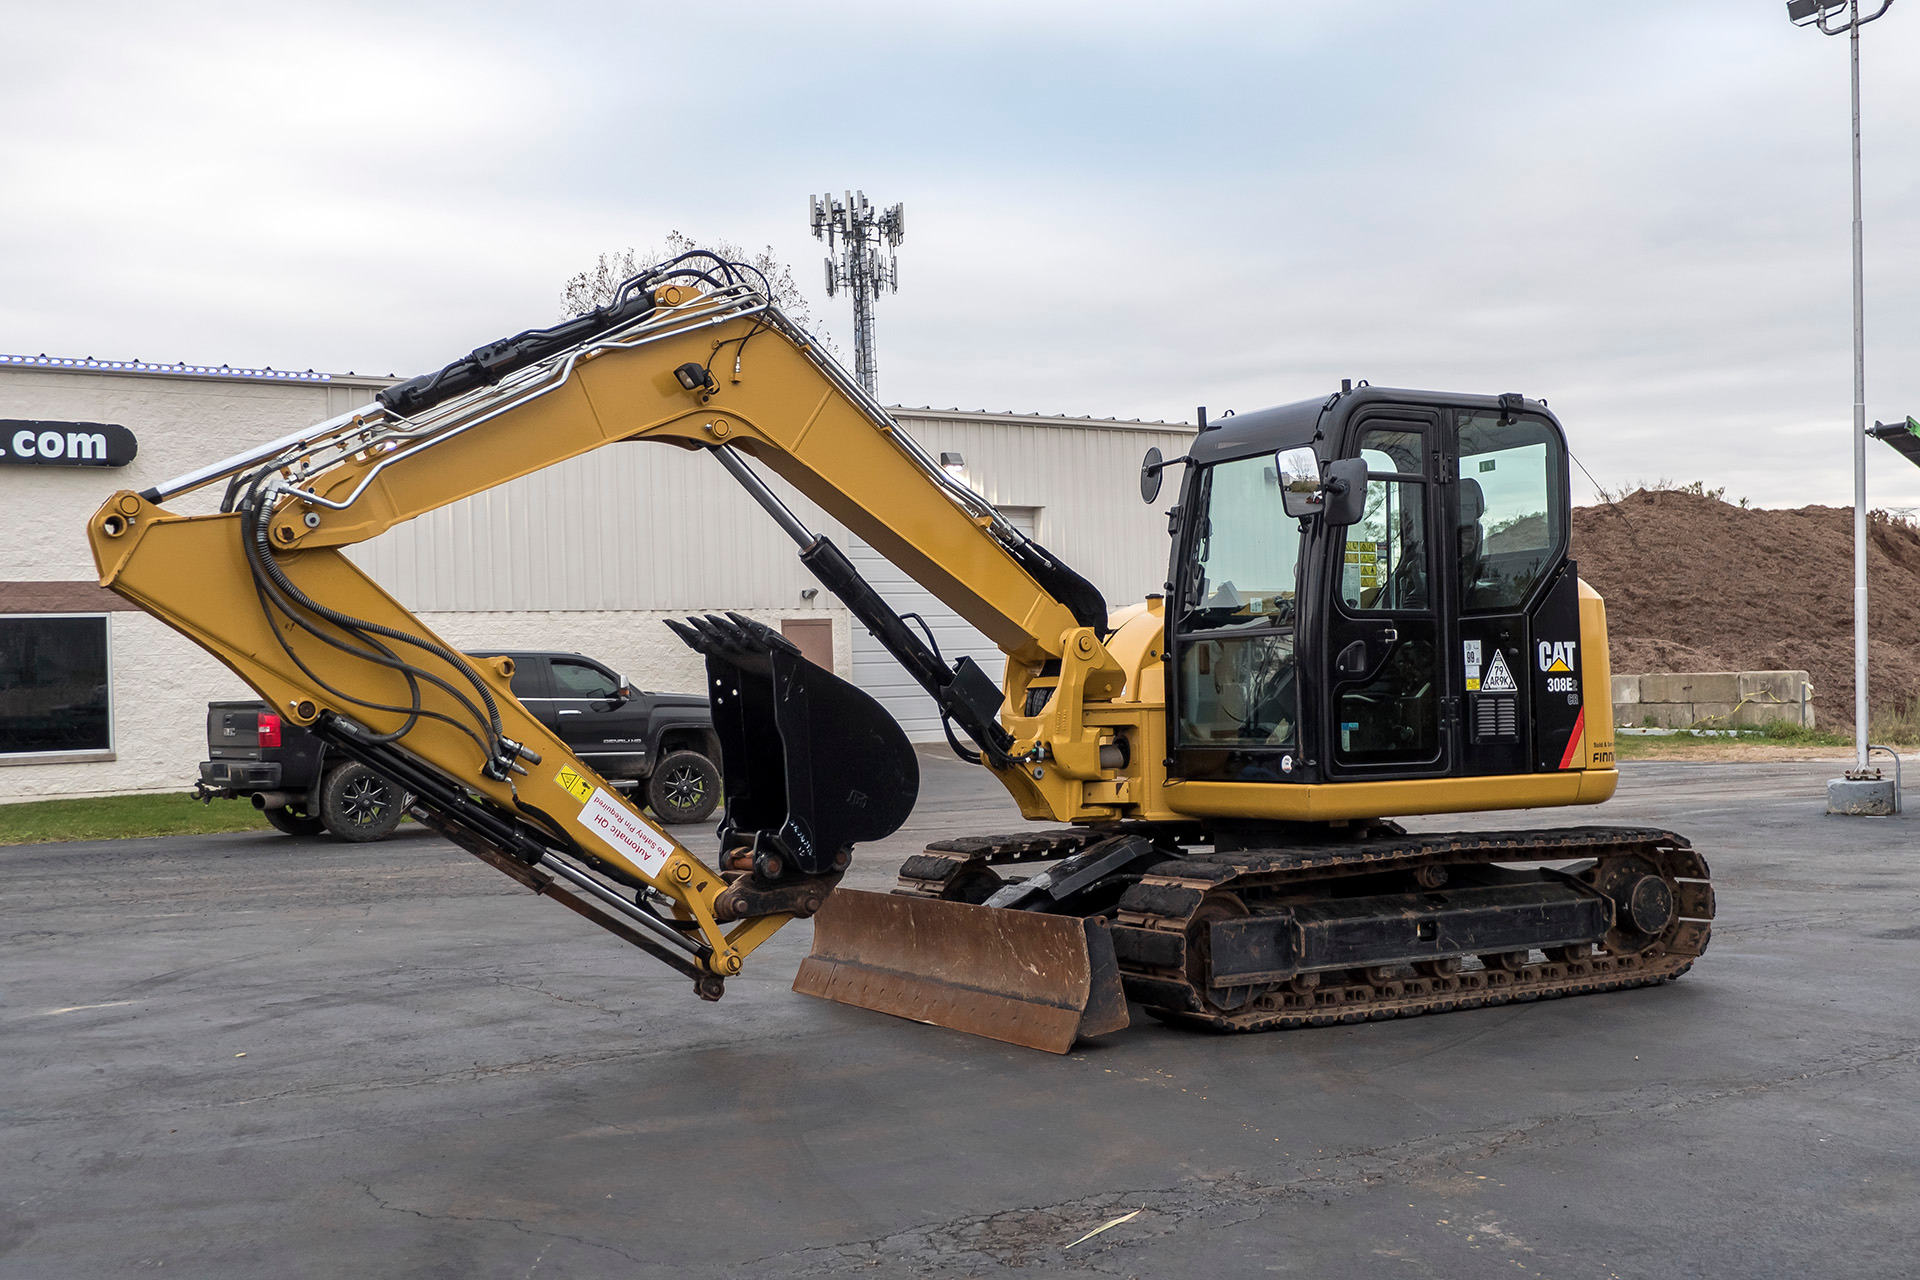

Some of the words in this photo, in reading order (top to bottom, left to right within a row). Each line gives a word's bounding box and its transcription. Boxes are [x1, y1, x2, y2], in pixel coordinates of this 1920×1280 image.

[1538, 641, 1576, 672] CAT
[1494, 665, 1504, 676] 79
[593, 796, 624, 824] Required
[593, 813, 609, 829] QH
[624, 821, 636, 833] Pin
[610, 825, 652, 861] Automatic
[635, 829, 657, 850] Safety
[656, 846, 668, 858] No
